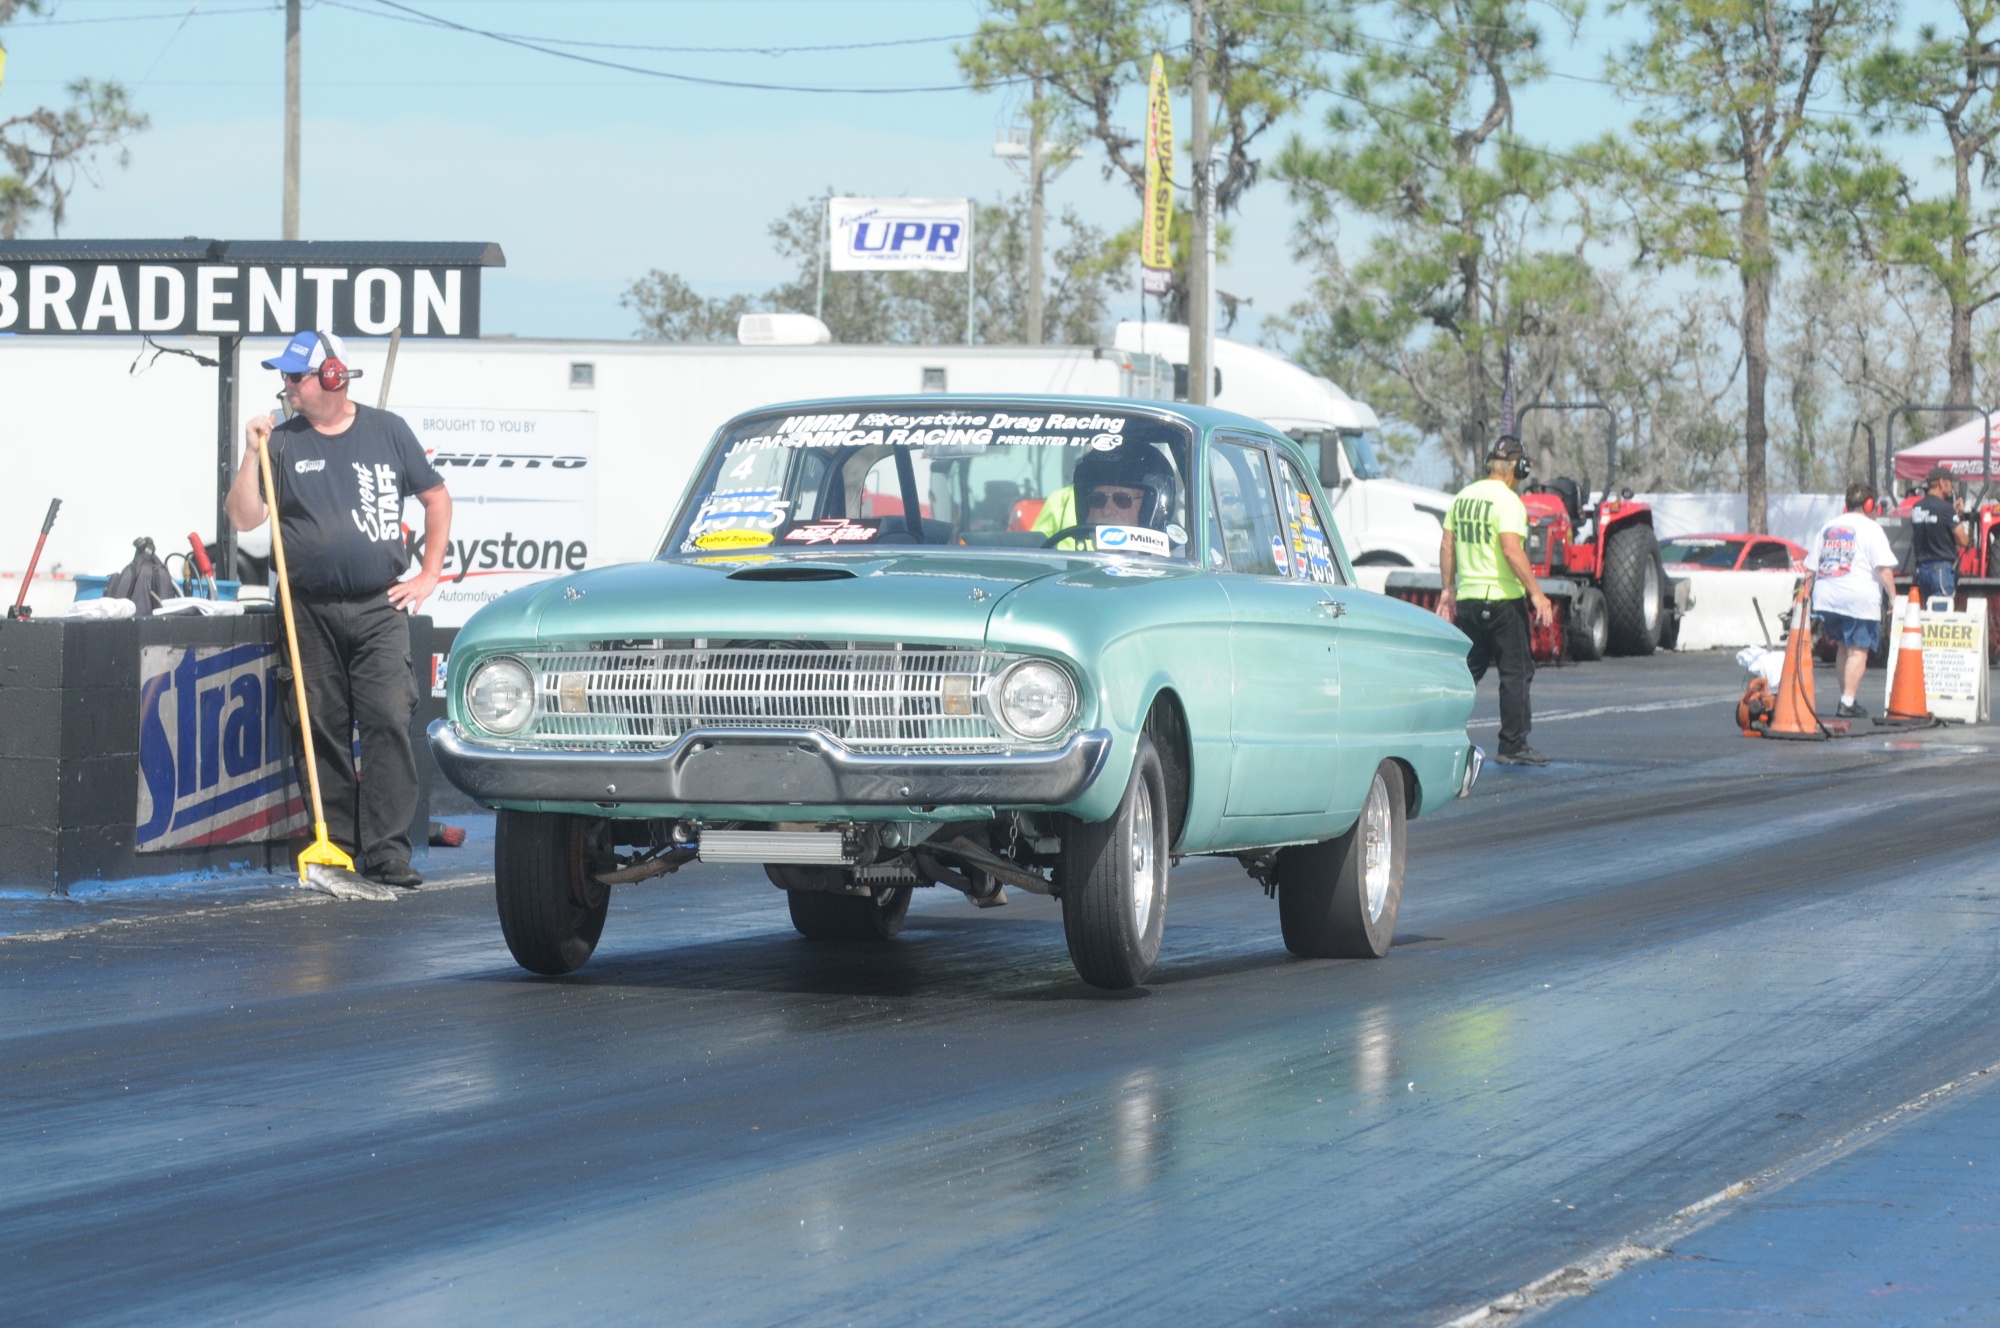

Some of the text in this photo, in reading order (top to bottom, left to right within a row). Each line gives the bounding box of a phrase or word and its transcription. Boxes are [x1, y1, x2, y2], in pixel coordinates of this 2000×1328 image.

[853, 222, 960, 252] UPR
[423, 418, 537, 433] BROUGHT TO YOU BY
[777, 413, 1126, 434] NMRA Keystone Drag Racing
[798, 429, 885, 448] NMCA
[885, 428, 994, 446] RACING
[996, 435, 1067, 446] PRESENTED
[1069, 437, 1089, 447] BY
[432, 453, 588, 469] NITTO
[730, 453, 757, 481] 4
[351, 461, 380, 543] Event
[374, 463, 399, 541] STAFF
[1130, 533, 1165, 547] Miller
[438, 589, 500, 603] Automotive
